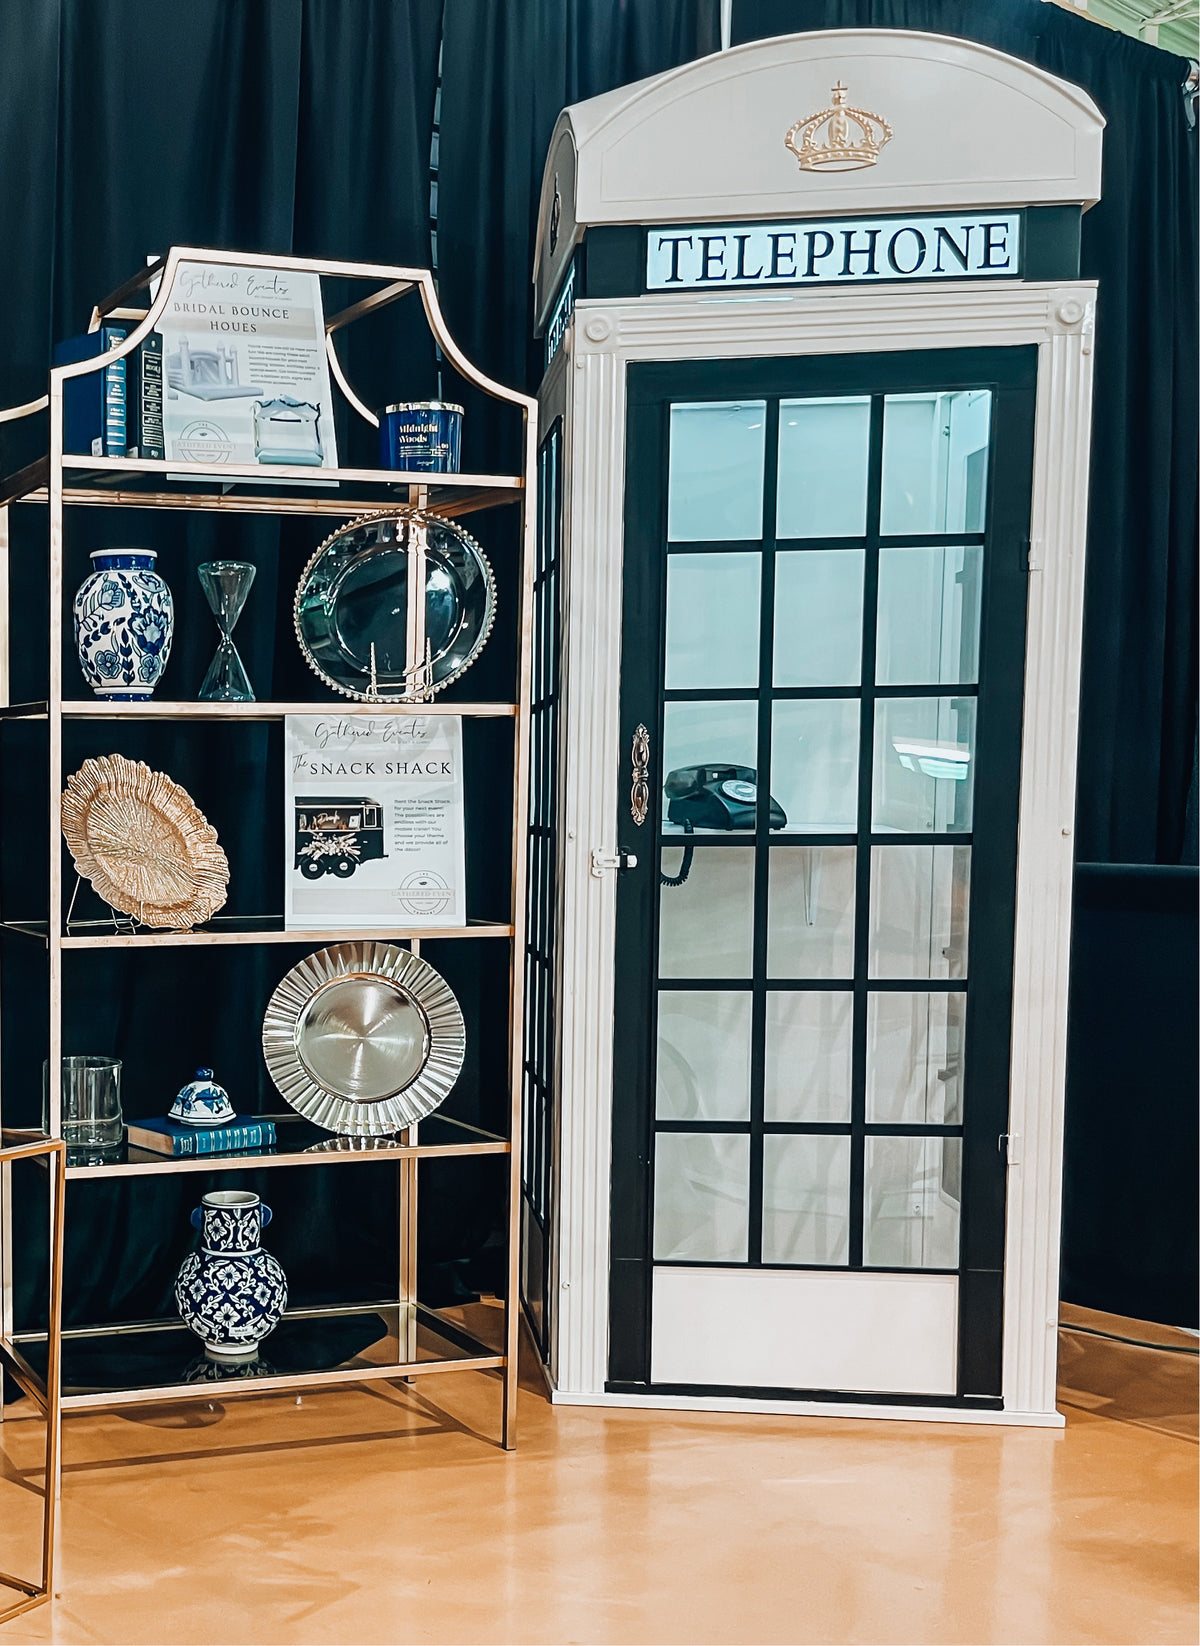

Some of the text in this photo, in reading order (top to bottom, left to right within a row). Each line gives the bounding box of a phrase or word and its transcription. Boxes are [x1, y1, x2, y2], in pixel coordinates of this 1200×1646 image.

[658, 222, 1011, 282] TELEPHONE
[180, 270, 289, 298] Gathered Events
[174, 303, 289, 319] BRIDAL BOUNCE
[210, 321, 257, 333] HOUES
[399, 424, 438, 433] Midnight
[399, 434, 427, 443] Woods
[315, 719, 427, 749] Gathered Events
[292, 753, 308, 774] The
[310, 762, 452, 775] SNACK SHACK
